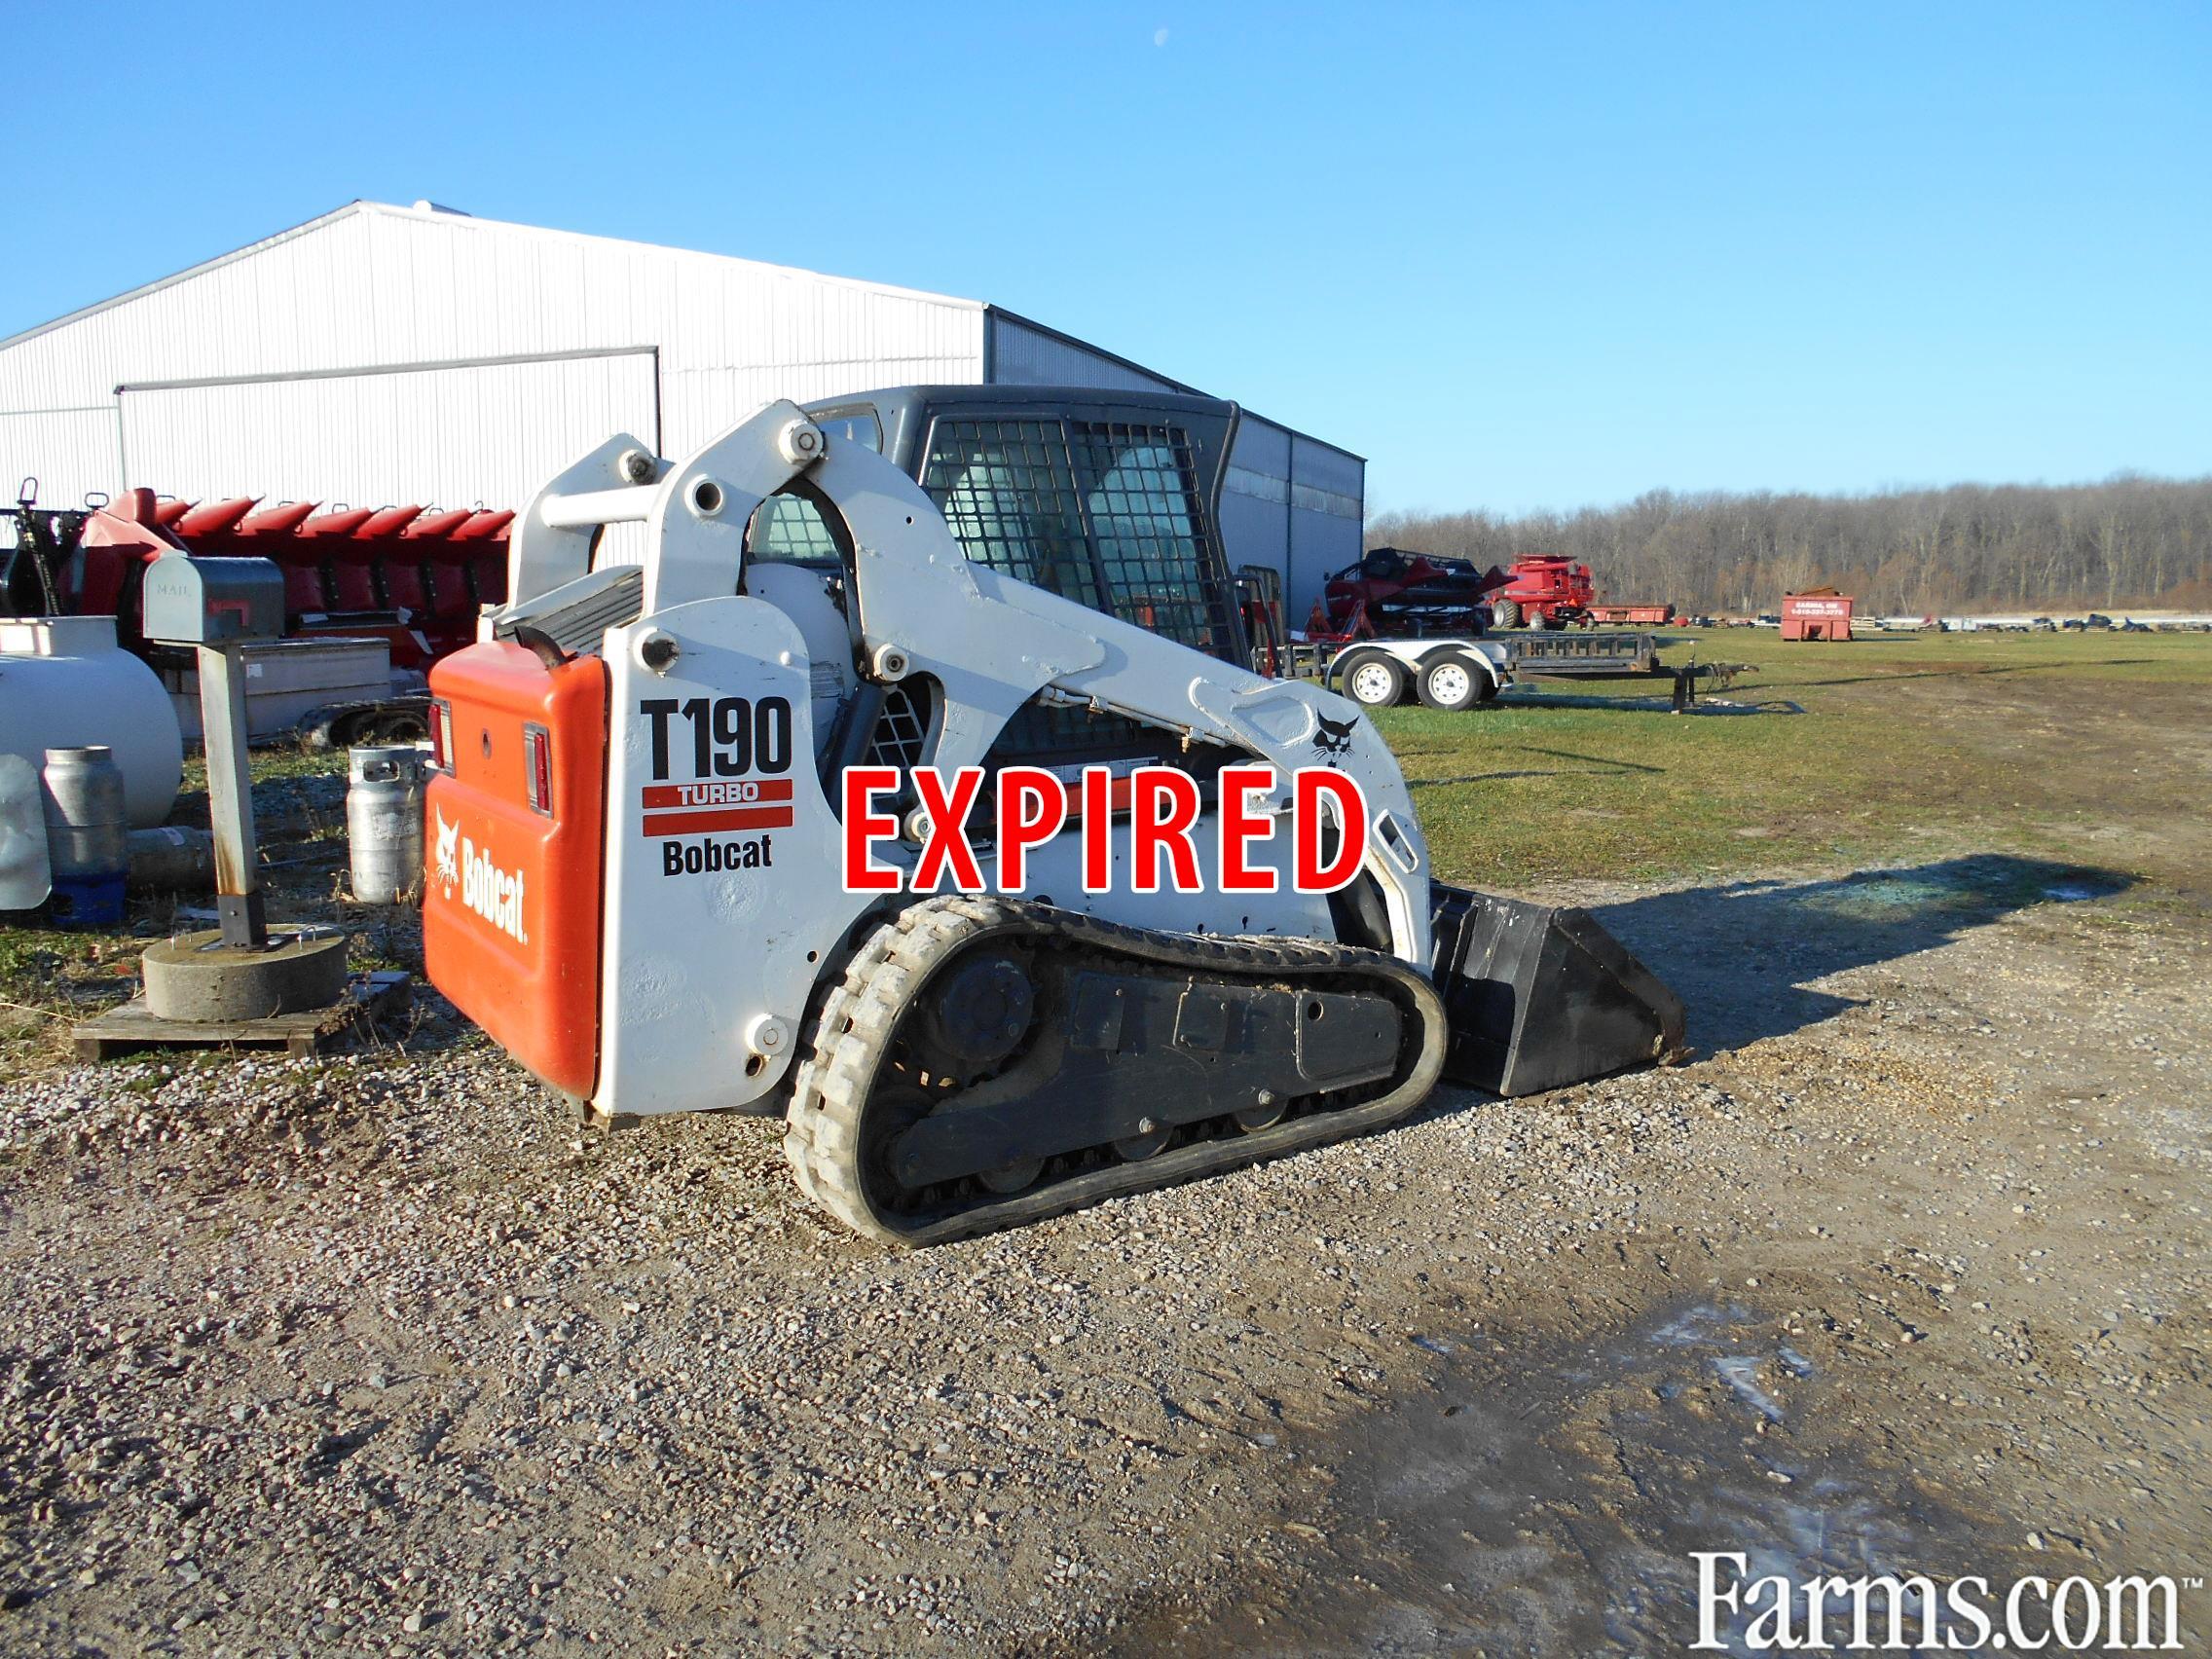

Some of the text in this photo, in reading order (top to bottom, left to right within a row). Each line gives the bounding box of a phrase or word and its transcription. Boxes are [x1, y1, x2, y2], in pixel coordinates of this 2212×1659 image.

[157, 583, 191, 597] MAIL
[641, 696, 792, 781] T190
[677, 782, 759, 806] TURBO
[663, 834, 772, 876] Bobcat
[462, 836, 524, 943] Bobcat
